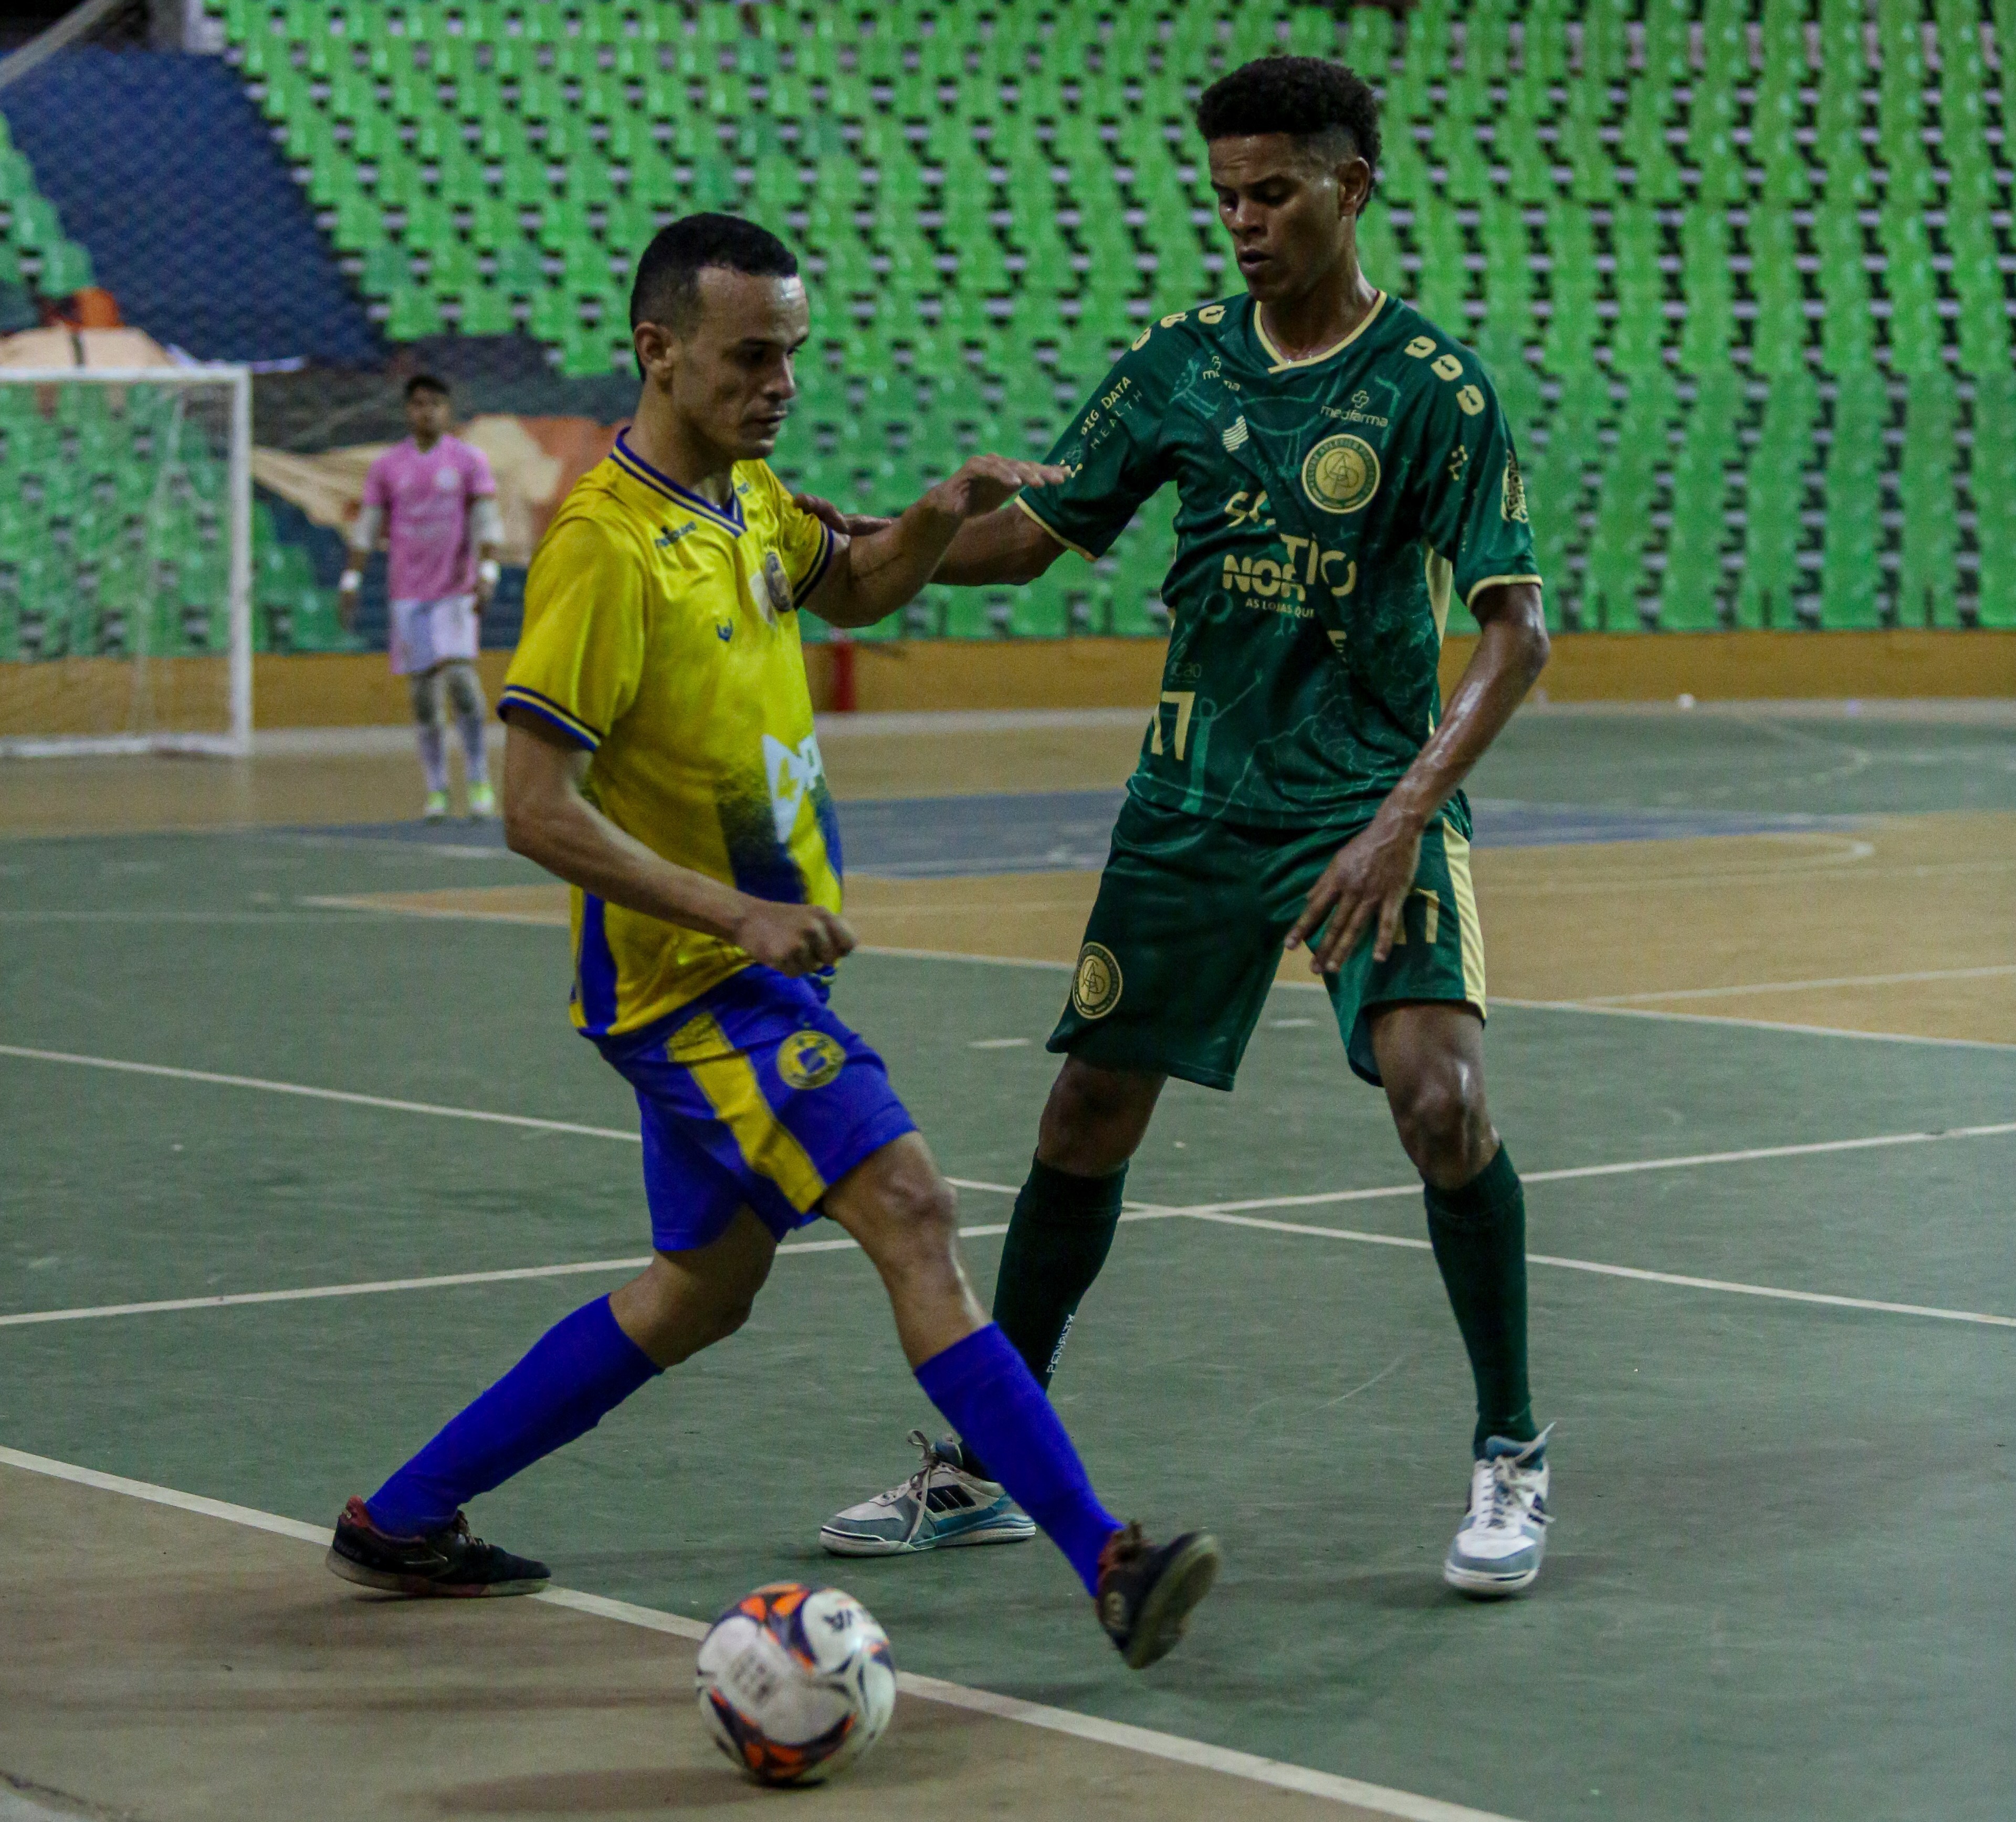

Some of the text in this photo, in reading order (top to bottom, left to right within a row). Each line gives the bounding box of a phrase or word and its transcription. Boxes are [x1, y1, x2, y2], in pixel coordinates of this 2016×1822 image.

[1101, 376, 1132, 410] DATA
[1320, 405, 1389, 427] medfarma
[1245, 598, 1260, 608] AS
